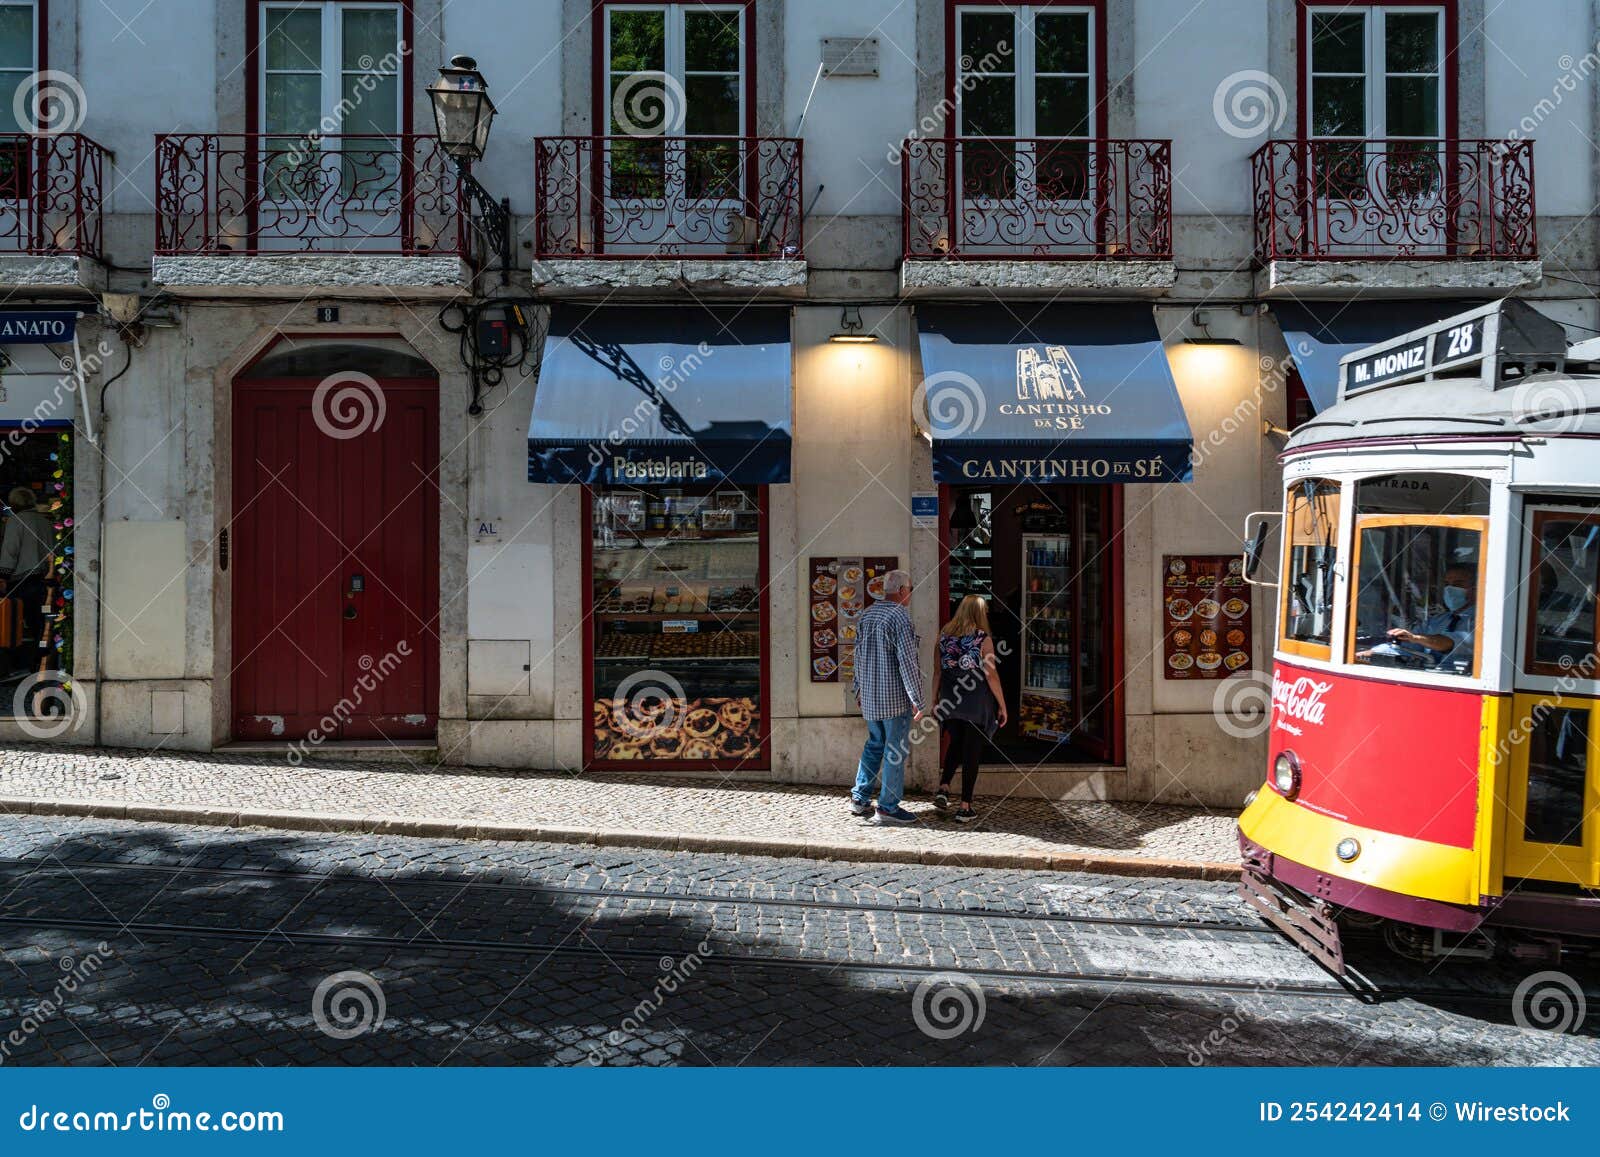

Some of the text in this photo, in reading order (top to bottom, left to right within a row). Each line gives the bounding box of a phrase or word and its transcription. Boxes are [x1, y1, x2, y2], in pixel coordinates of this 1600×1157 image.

[324, 308, 332, 321] 8
[1, 320, 65, 336] ANATO
[1447, 323, 1474, 358] 28
[1355, 345, 1425, 383] M. MONIZ
[999, 403, 1112, 415] CANTINHO
[1034, 414, 1085, 430] DA SÉ
[613, 456, 707, 478] Pastelaria
[962, 455, 1163, 478] CANTINHO DA SÉ
[479, 522, 497, 534] AL
